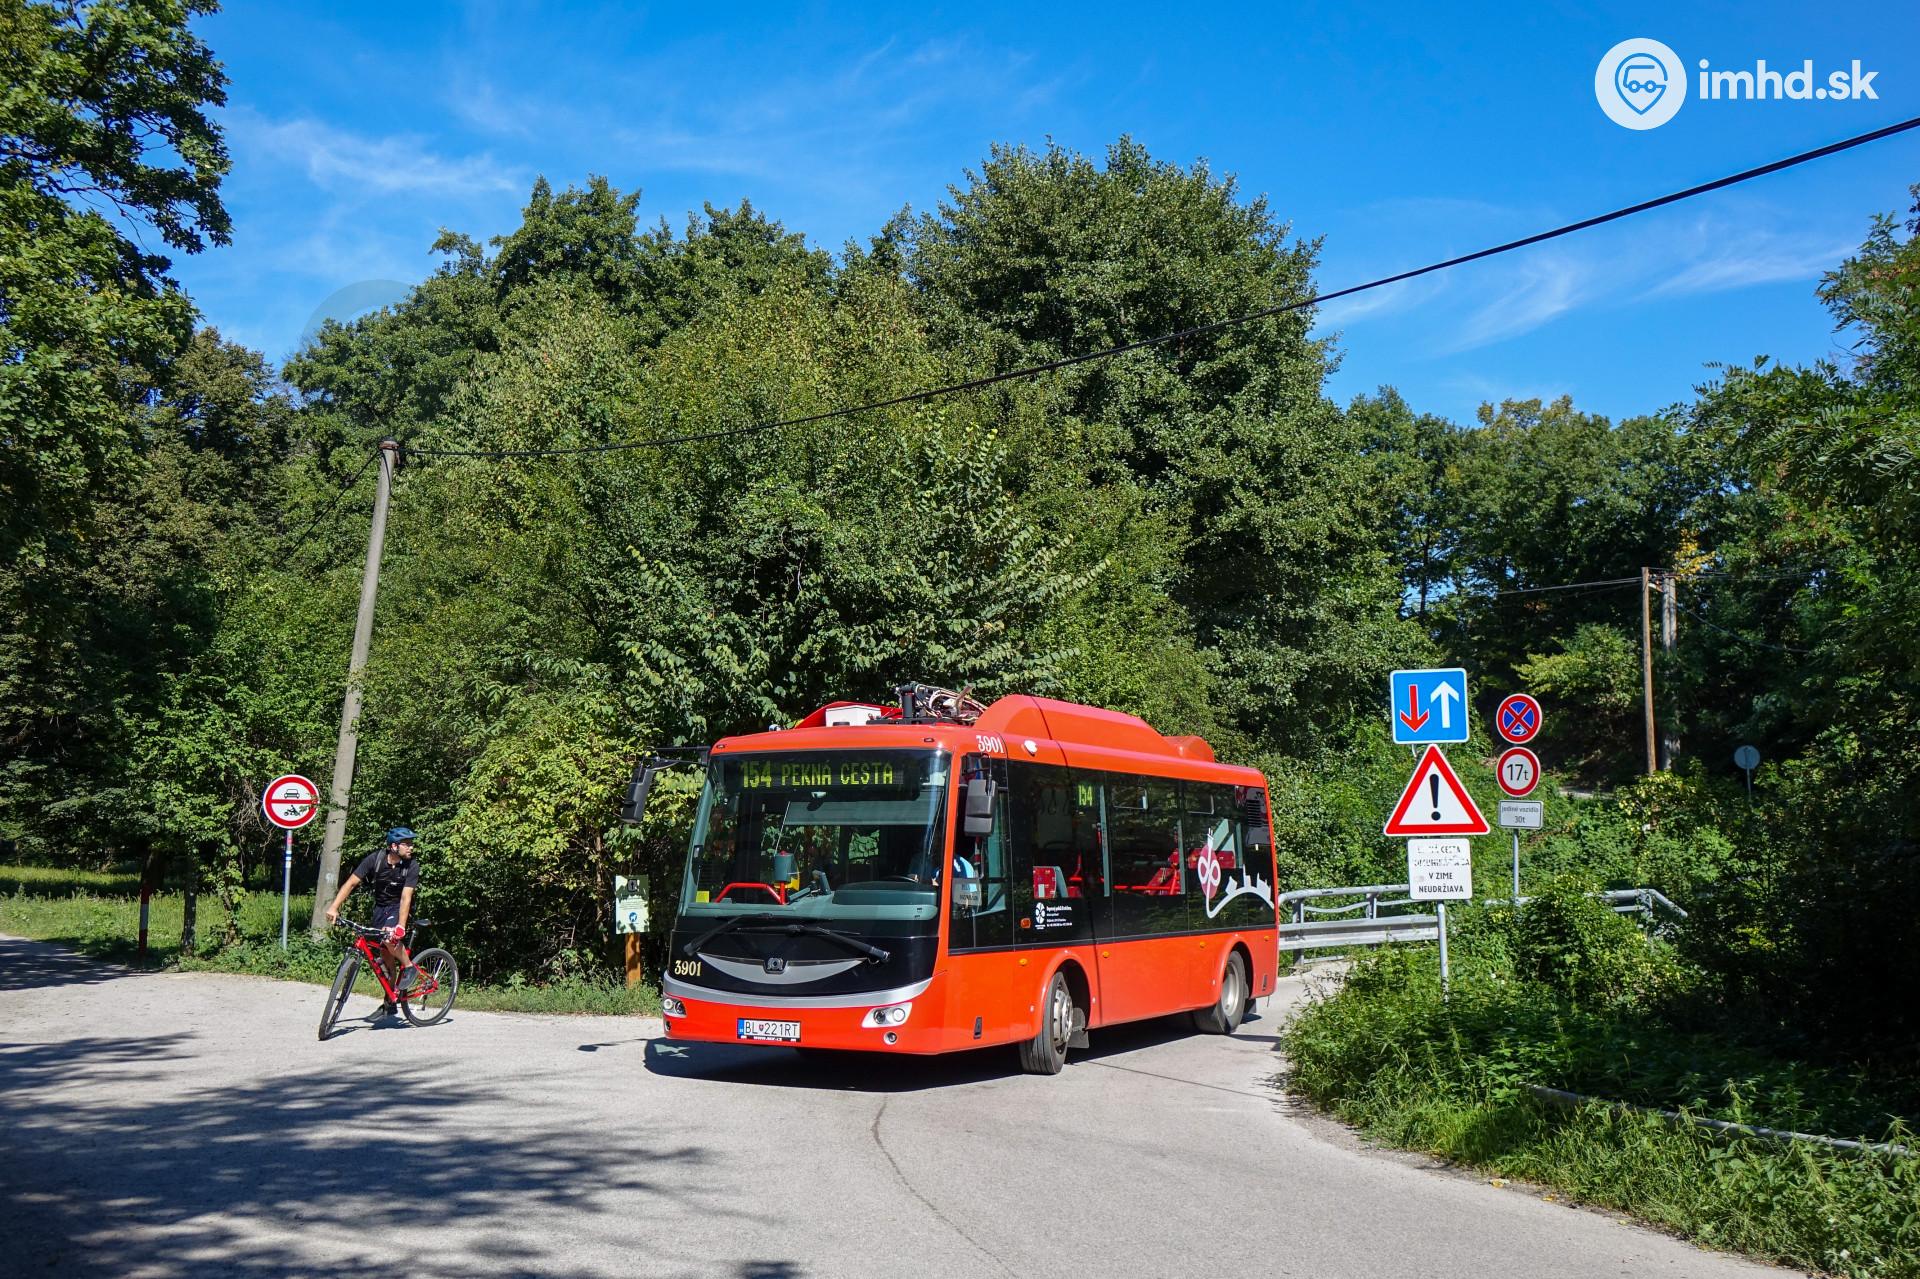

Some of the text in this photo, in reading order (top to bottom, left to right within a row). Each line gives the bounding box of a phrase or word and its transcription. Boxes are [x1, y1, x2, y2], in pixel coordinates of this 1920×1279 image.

[975, 734, 1005, 754] 3901
[740, 760, 772, 788] 154
[840, 761, 894, 785] CESTA
[1506, 763, 1529, 781] 17t
[1077, 784, 1093, 807] 154
[1428, 872, 1453, 880] V ZIME
[1418, 883, 1464, 893] NEUDRŽIAVA
[674, 959, 702, 977] 3901
